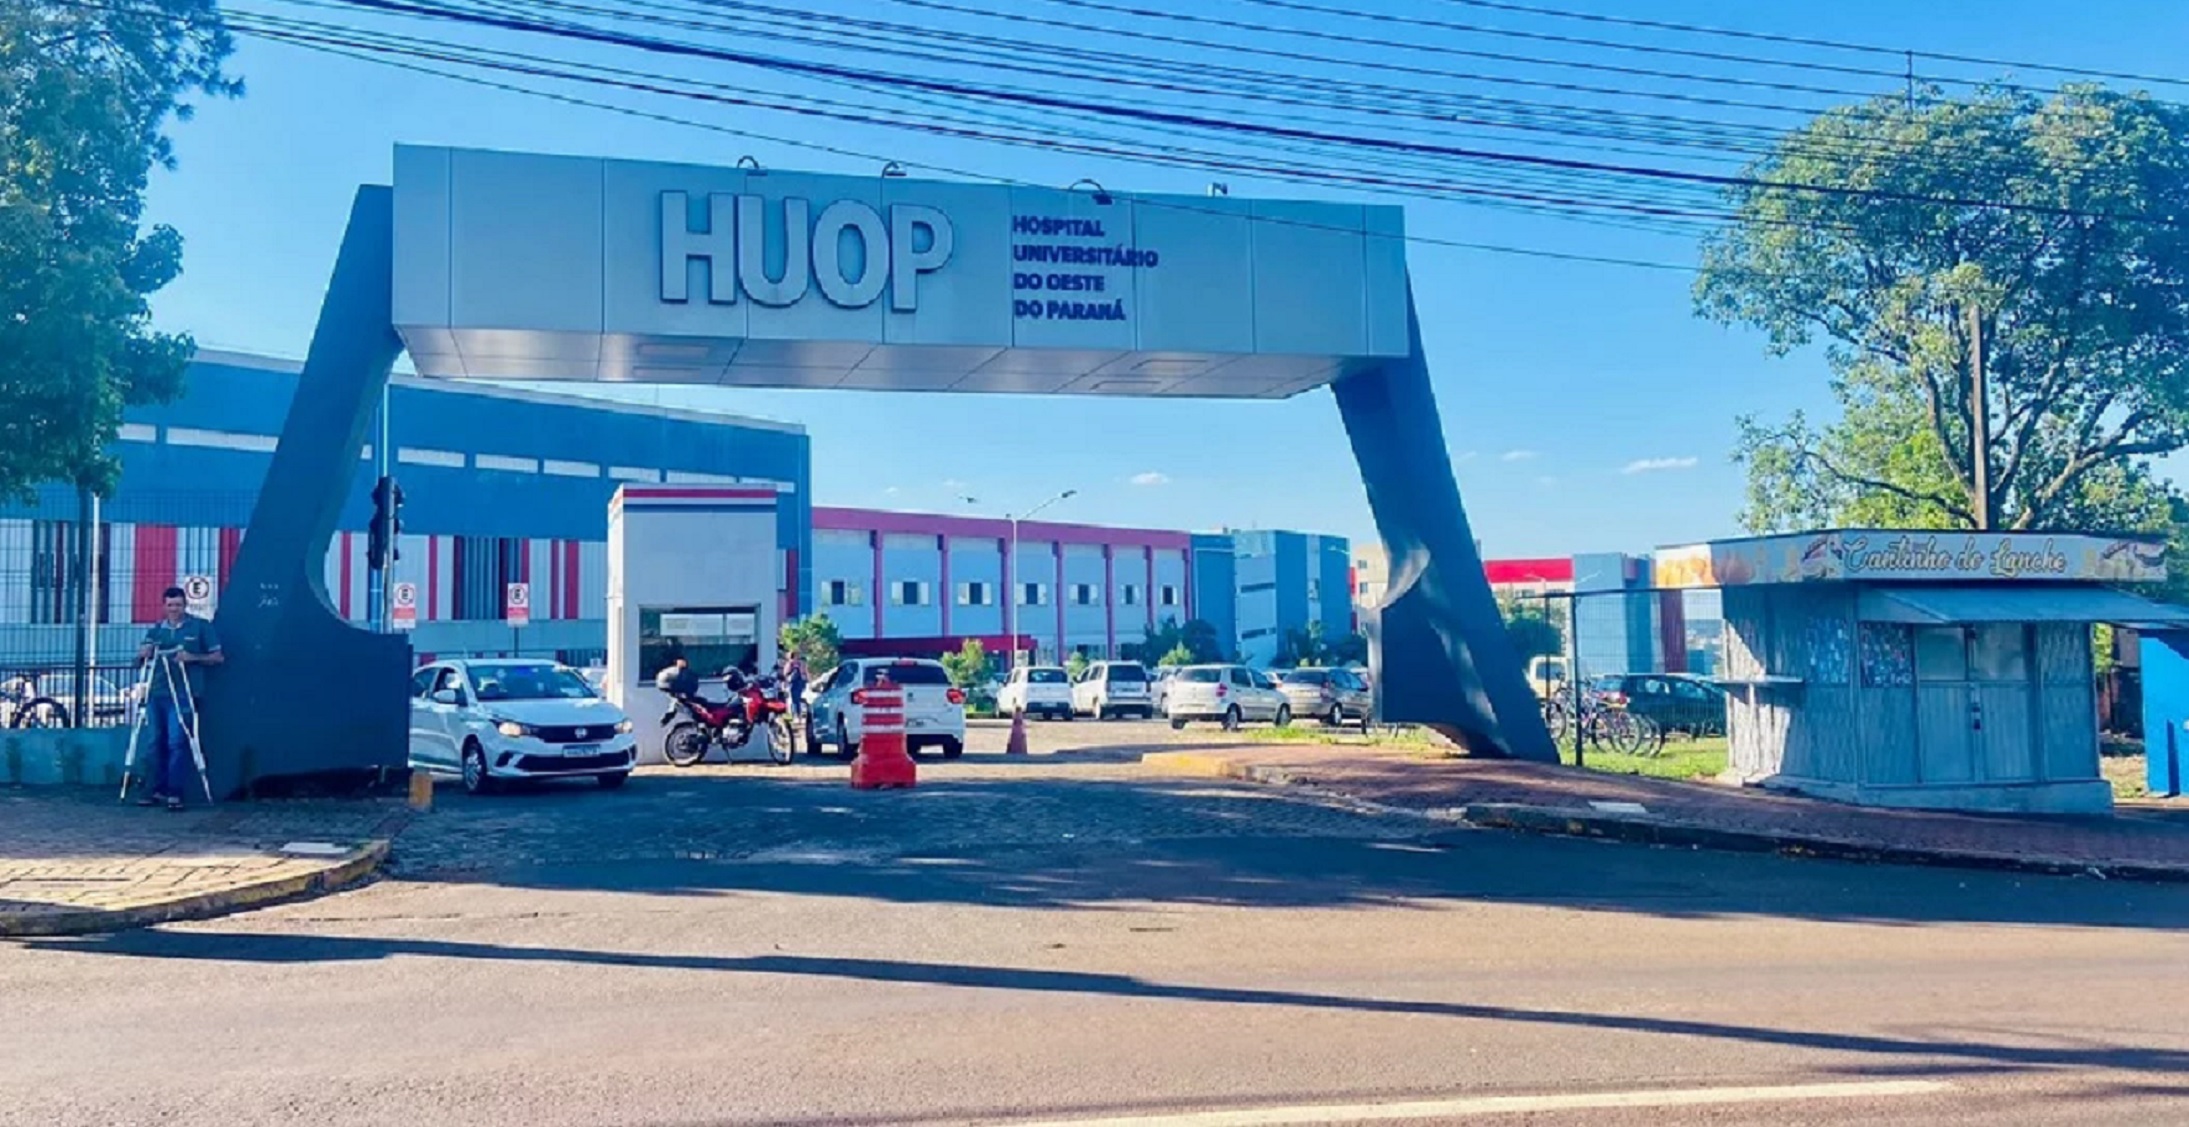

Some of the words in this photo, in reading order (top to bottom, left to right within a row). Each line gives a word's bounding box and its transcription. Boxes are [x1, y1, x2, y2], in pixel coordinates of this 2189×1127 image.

[1013, 215, 1105, 237] HOSPITAL
[659, 189, 954, 313] HUOP
[1013, 243, 1159, 268] UNIVERSITÁRIO
[1013, 273, 1043, 290] DO
[1046, 274, 1105, 292] OESTE
[1014, 299, 1043, 318] DO
[1046, 298, 1126, 321] PARANÁ
[1842, 535, 1951, 571] Cantinho
[1954, 536, 1985, 570] do
[1989, 537, 2067, 578] Lanche
[193, 582, 201, 594] E
